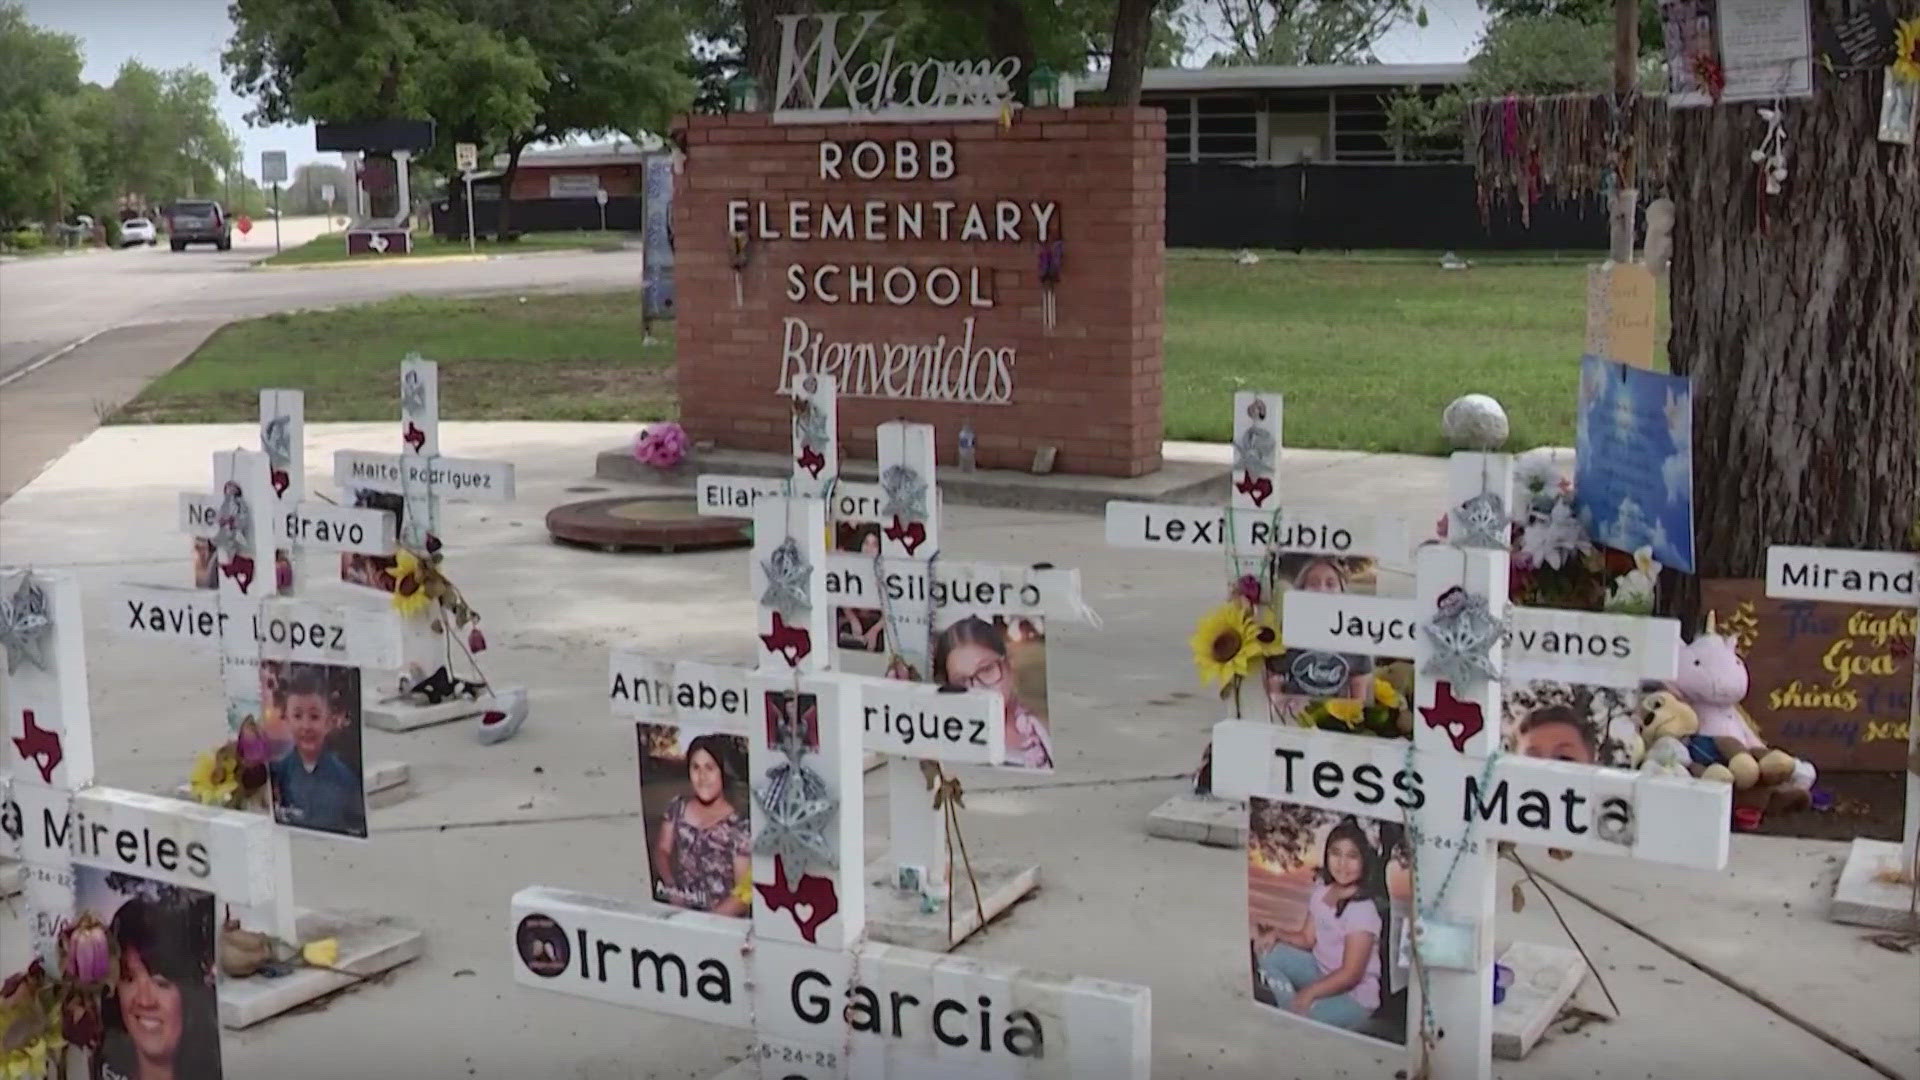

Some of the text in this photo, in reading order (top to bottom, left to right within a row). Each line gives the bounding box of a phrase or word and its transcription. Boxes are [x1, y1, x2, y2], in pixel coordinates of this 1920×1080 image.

[775, 10, 1021, 111] Welcome
[820, 139, 955, 180] ROBB
[728, 201, 1056, 242] ELEMENTARY
[785, 263, 994, 307] SCHOOL
[776, 316, 1016, 404] Bienvenidos
[353, 461, 491, 489] Maite Rodriguez
[285, 510, 364, 545] Bravo
[1144, 515, 1353, 550] Lexi Rubio
[886, 572, 1041, 608] Silguero
[1781, 561, 1913, 596] Mirand
[129, 600, 348, 653] Xavier Lopez
[1506, 629, 1631, 659] vanos
[863, 702, 990, 746] riguez
[1274, 747, 1634, 841] Tess Mata
[43, 807, 211, 879] Mireles
[576, 927, 1045, 1060] Irma Garcia
